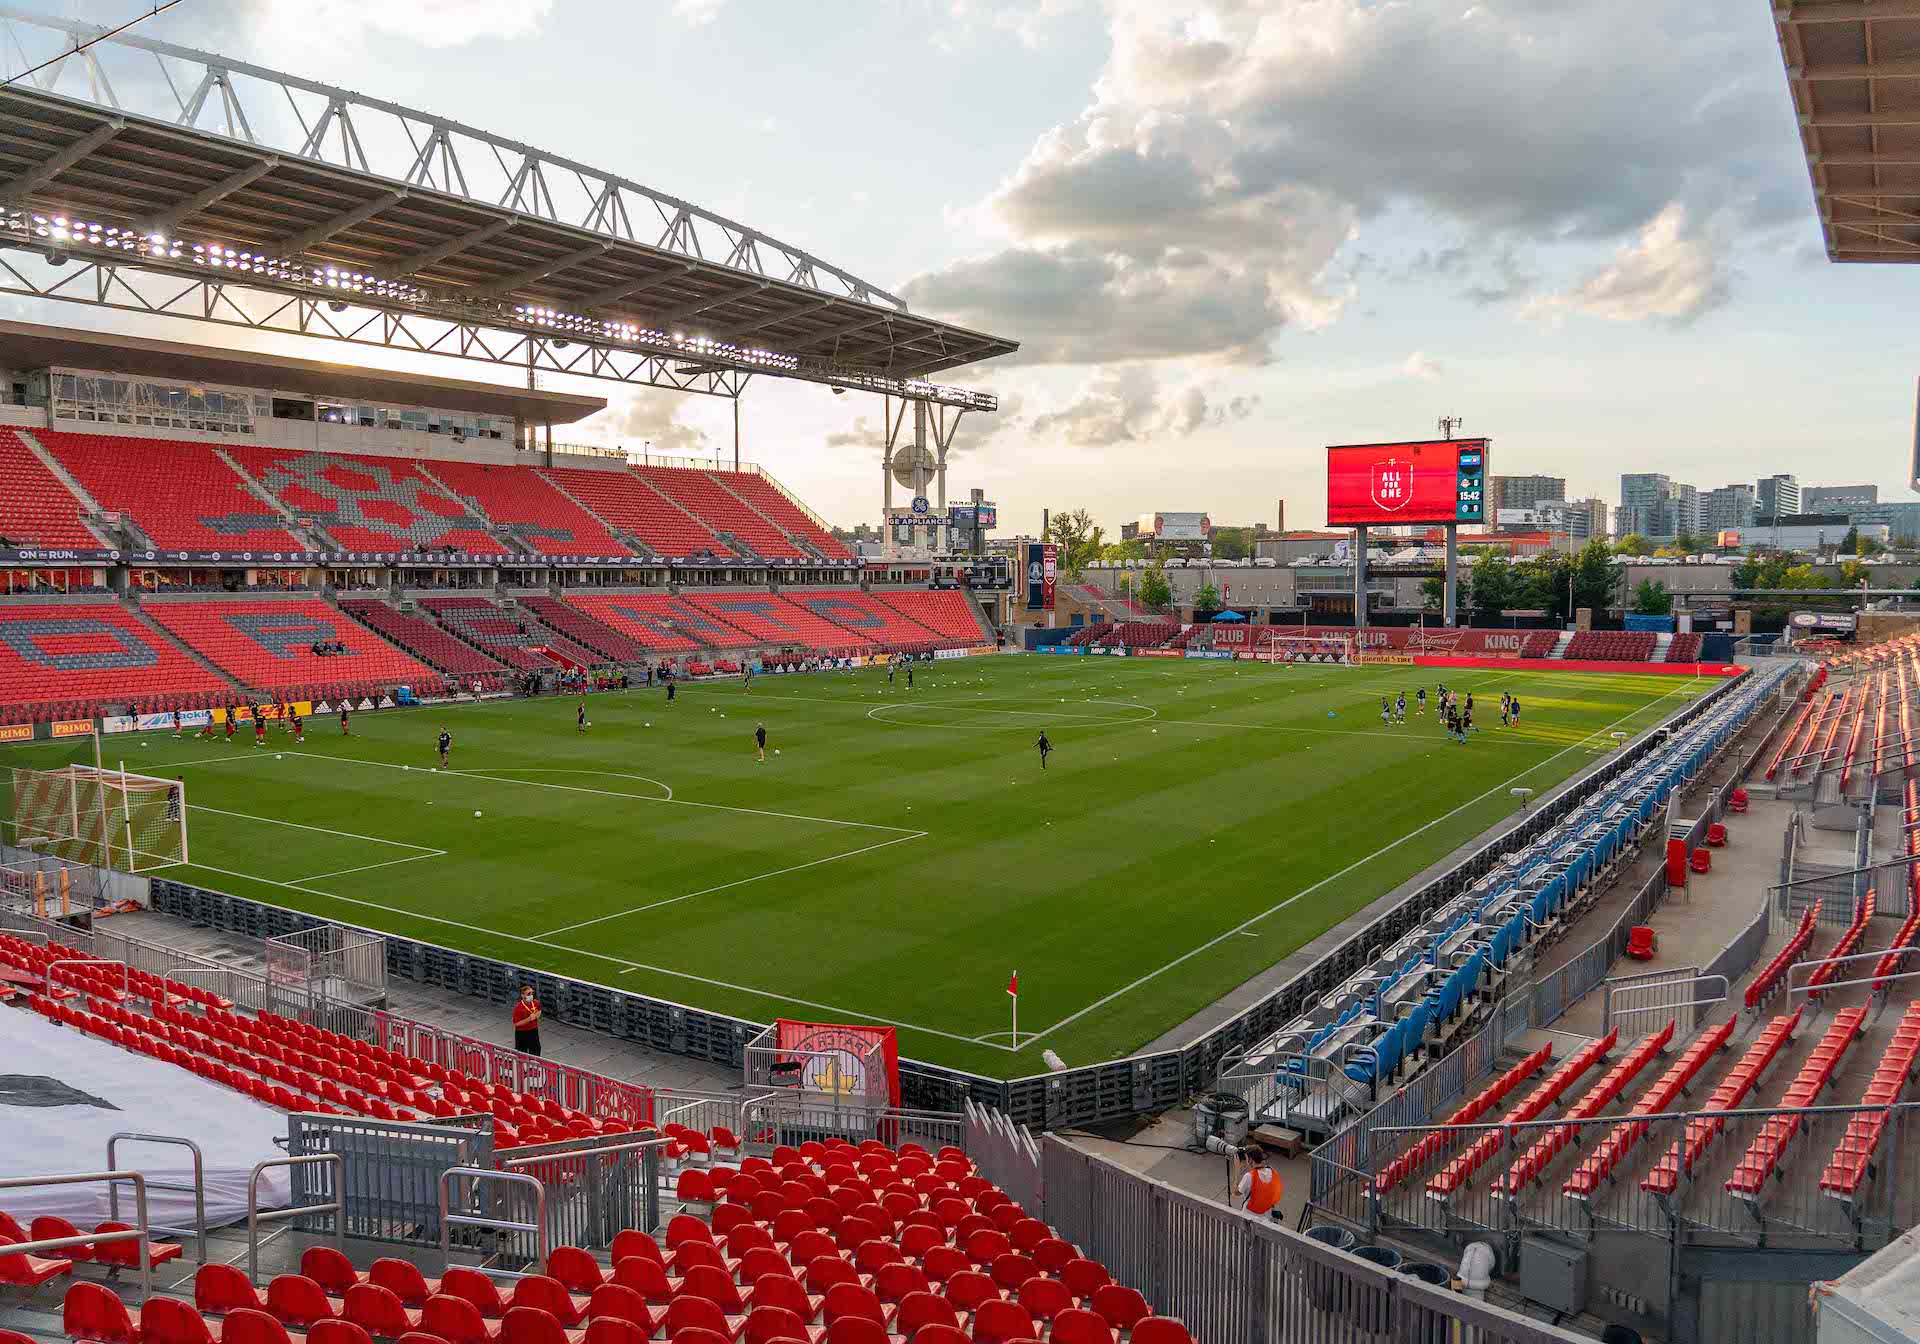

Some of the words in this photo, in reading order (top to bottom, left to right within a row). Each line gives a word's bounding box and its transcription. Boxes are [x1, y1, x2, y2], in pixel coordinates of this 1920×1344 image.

[1382, 472, 1401, 481] ALL
[1380, 489, 1402, 498] ONE
[19, 550, 37, 559] ON
[49, 550, 79, 559] RUN.
[1214, 629, 1244, 643] CLUB
[1409, 633, 1458, 645] Budweiser
[1485, 634, 1520, 650] KING
[0, 727, 31, 739] RIMO
[55, 722, 91, 734] PRIMO
